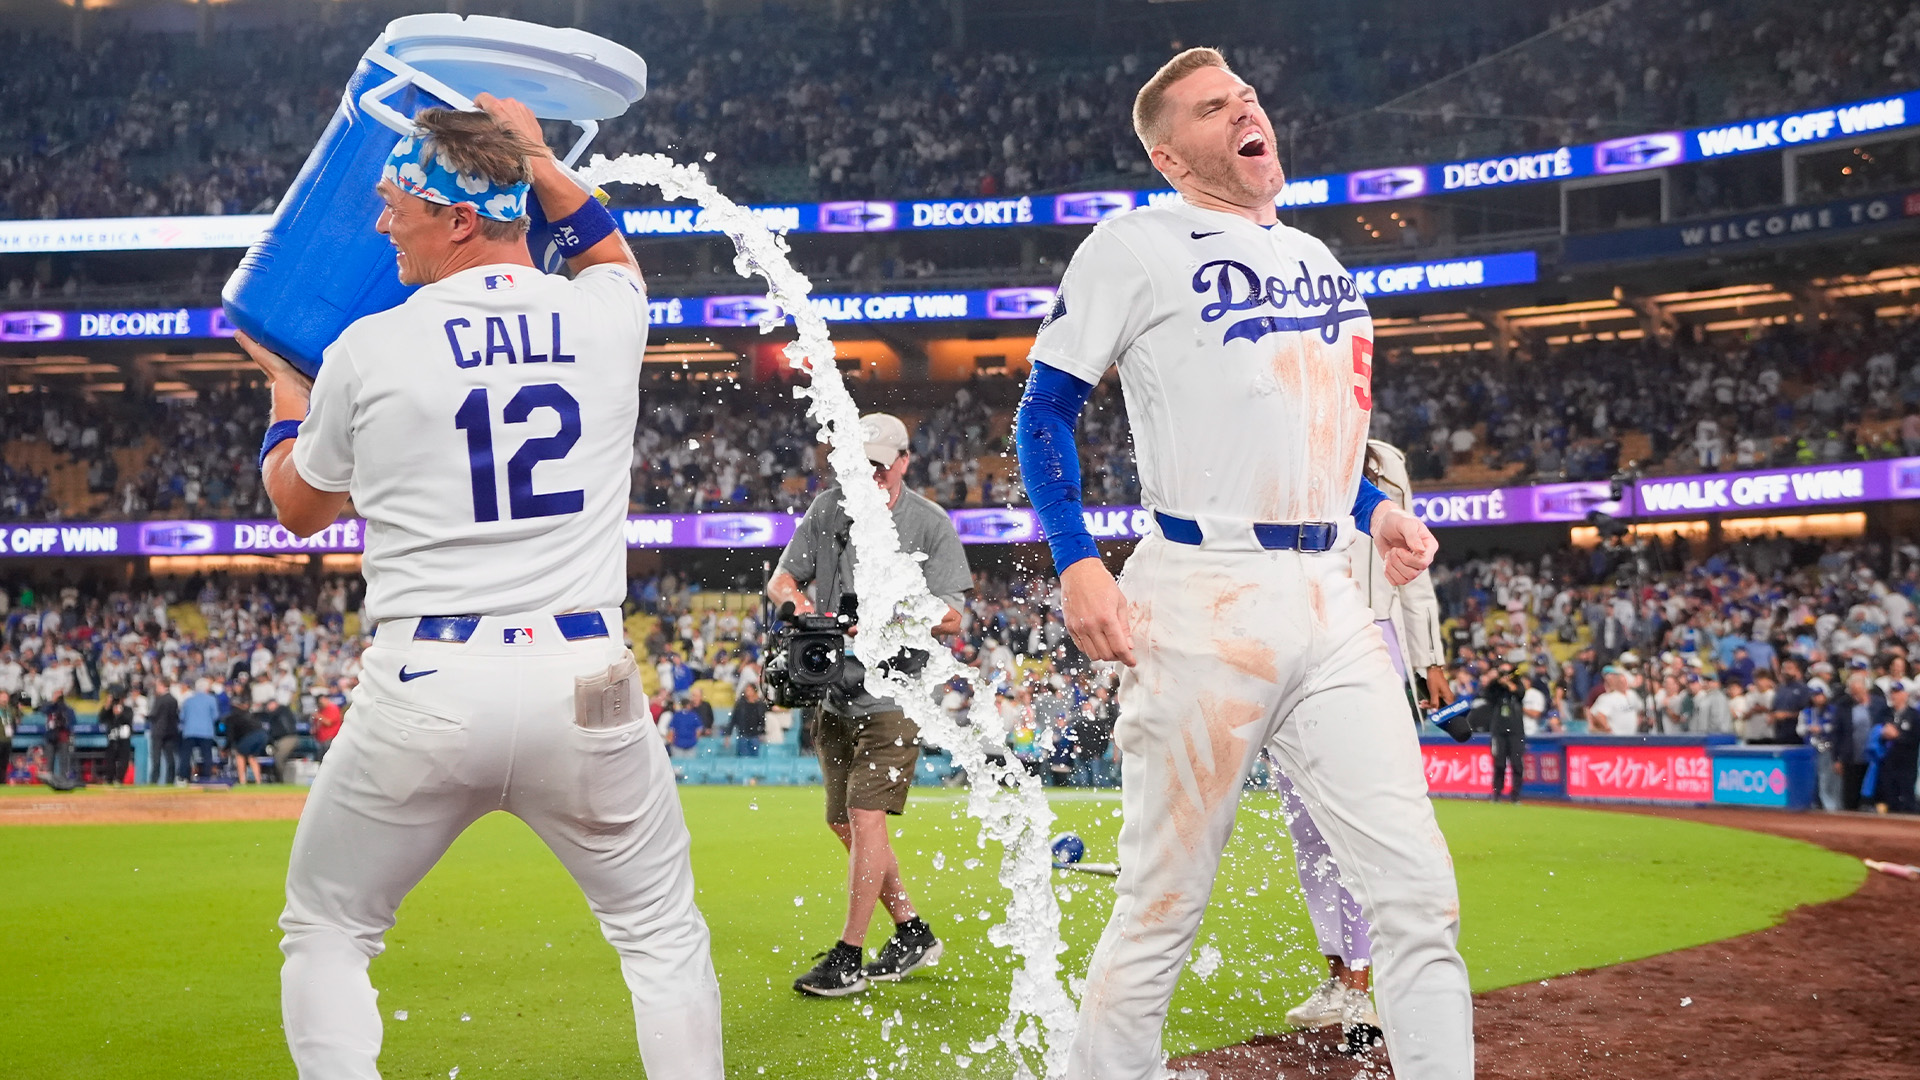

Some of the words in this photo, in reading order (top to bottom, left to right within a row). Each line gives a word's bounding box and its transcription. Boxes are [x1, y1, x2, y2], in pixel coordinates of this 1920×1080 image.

[1698, 120, 1779, 156] WALK
[1781, 110, 1836, 143] OFF
[1837, 98, 1905, 135] WIN!
[1443, 147, 1573, 189] DECORTÉ
[623, 209, 695, 233] WALK
[912, 196, 1033, 227] DECORTÉ
[1681, 209, 1832, 246] WELCOME
[1849, 201, 1889, 224] TO
[57, 232, 141, 246] AMERICA
[1377, 266, 1424, 293] OFF
[1426, 260, 1483, 288] WIN!
[864, 296, 912, 320] OFF
[913, 294, 968, 318] WIN!
[1192, 259, 1366, 344] Dodge
[79, 308, 191, 337] DECORTÉ
[444, 312, 576, 370] CALL
[1352, 335, 1374, 411] 5
[455, 383, 585, 523] 12
[1412, 488, 1506, 523] CORTÉ
[1641, 479, 1729, 511] WALK
[1731, 474, 1789, 505] OFF
[1791, 468, 1864, 501] WIN!
[11, 528, 59, 553] OFF
[60, 527, 118, 552] WIN!
[1674, 756, 1709, 778] 6.12
[1717, 768, 1767, 793] ARCO
